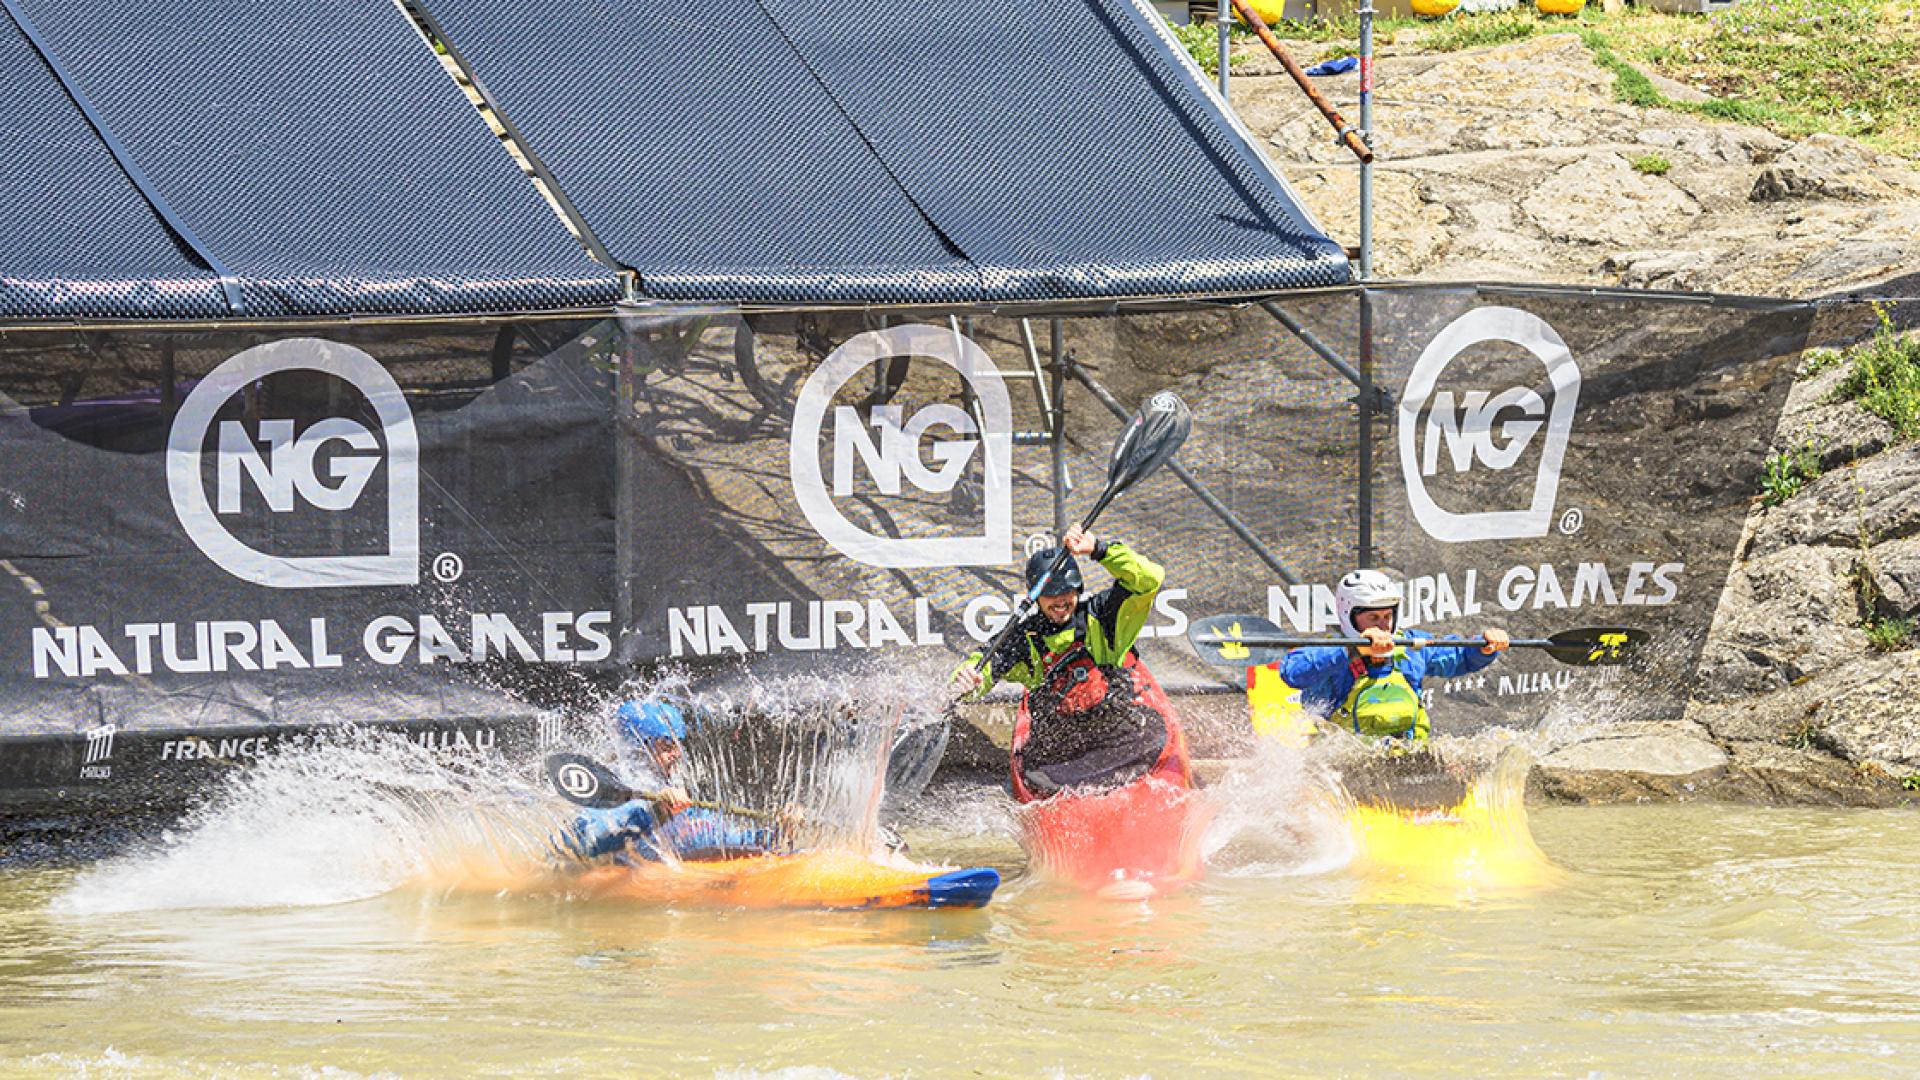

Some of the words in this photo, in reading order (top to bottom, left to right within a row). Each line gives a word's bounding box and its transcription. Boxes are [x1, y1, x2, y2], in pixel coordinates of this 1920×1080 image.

[217, 417, 382, 514] NG
[833, 403, 980, 497] NG
[1422, 387, 1546, 477] NG
[667, 597, 945, 657] NATURAL
[1267, 569, 1482, 633] NAURAL
[1497, 562, 1685, 611] GAMES
[32, 617, 343, 678] NATURAL
[362, 611, 612, 665] GAMES
[1498, 670, 1570, 696] MILLAU
[161, 737, 270, 761] FRANCE
